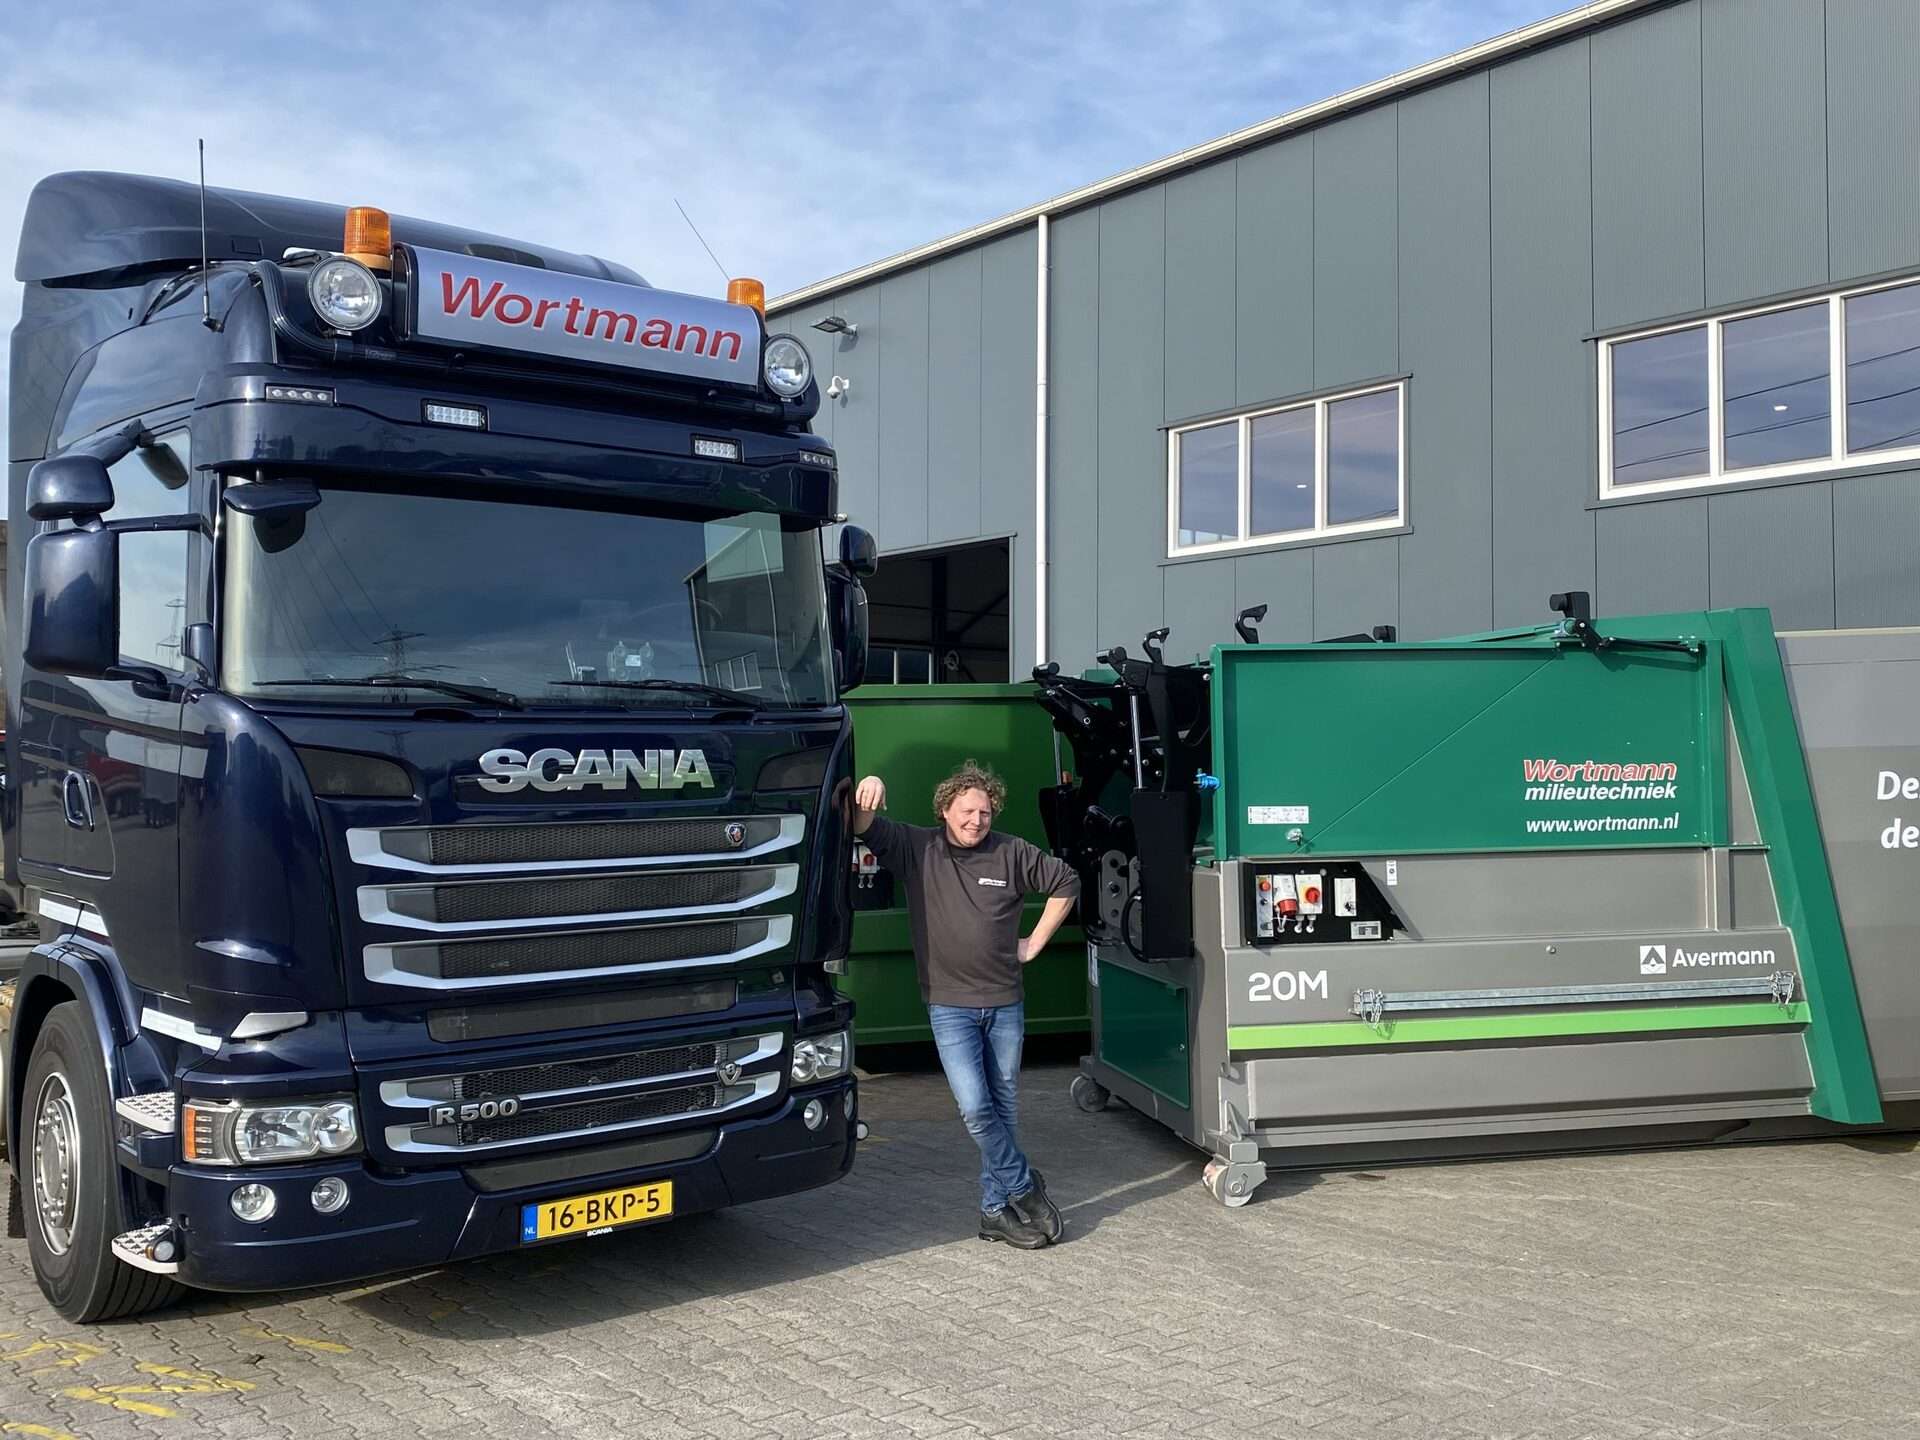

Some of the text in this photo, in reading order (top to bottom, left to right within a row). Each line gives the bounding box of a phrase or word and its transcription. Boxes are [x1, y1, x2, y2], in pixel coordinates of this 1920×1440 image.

[440, 271, 743, 361] Wortmann
[477, 748, 715, 793] SCANIA
[1523, 759, 1677, 782] Wortmann
[1525, 782, 1677, 800] milieutechniek
[1877, 771, 1920, 800] De
[1526, 812, 1680, 832] www.wortmann.nl
[1881, 818, 1920, 848] de
[1672, 949, 1776, 967] Avermann
[1248, 970, 1329, 1001] 20M
[436, 1099, 519, 1125] R 500
[548, 1188, 660, 1232] 16-BKP-5
[525, 1226, 536, 1235] NL
